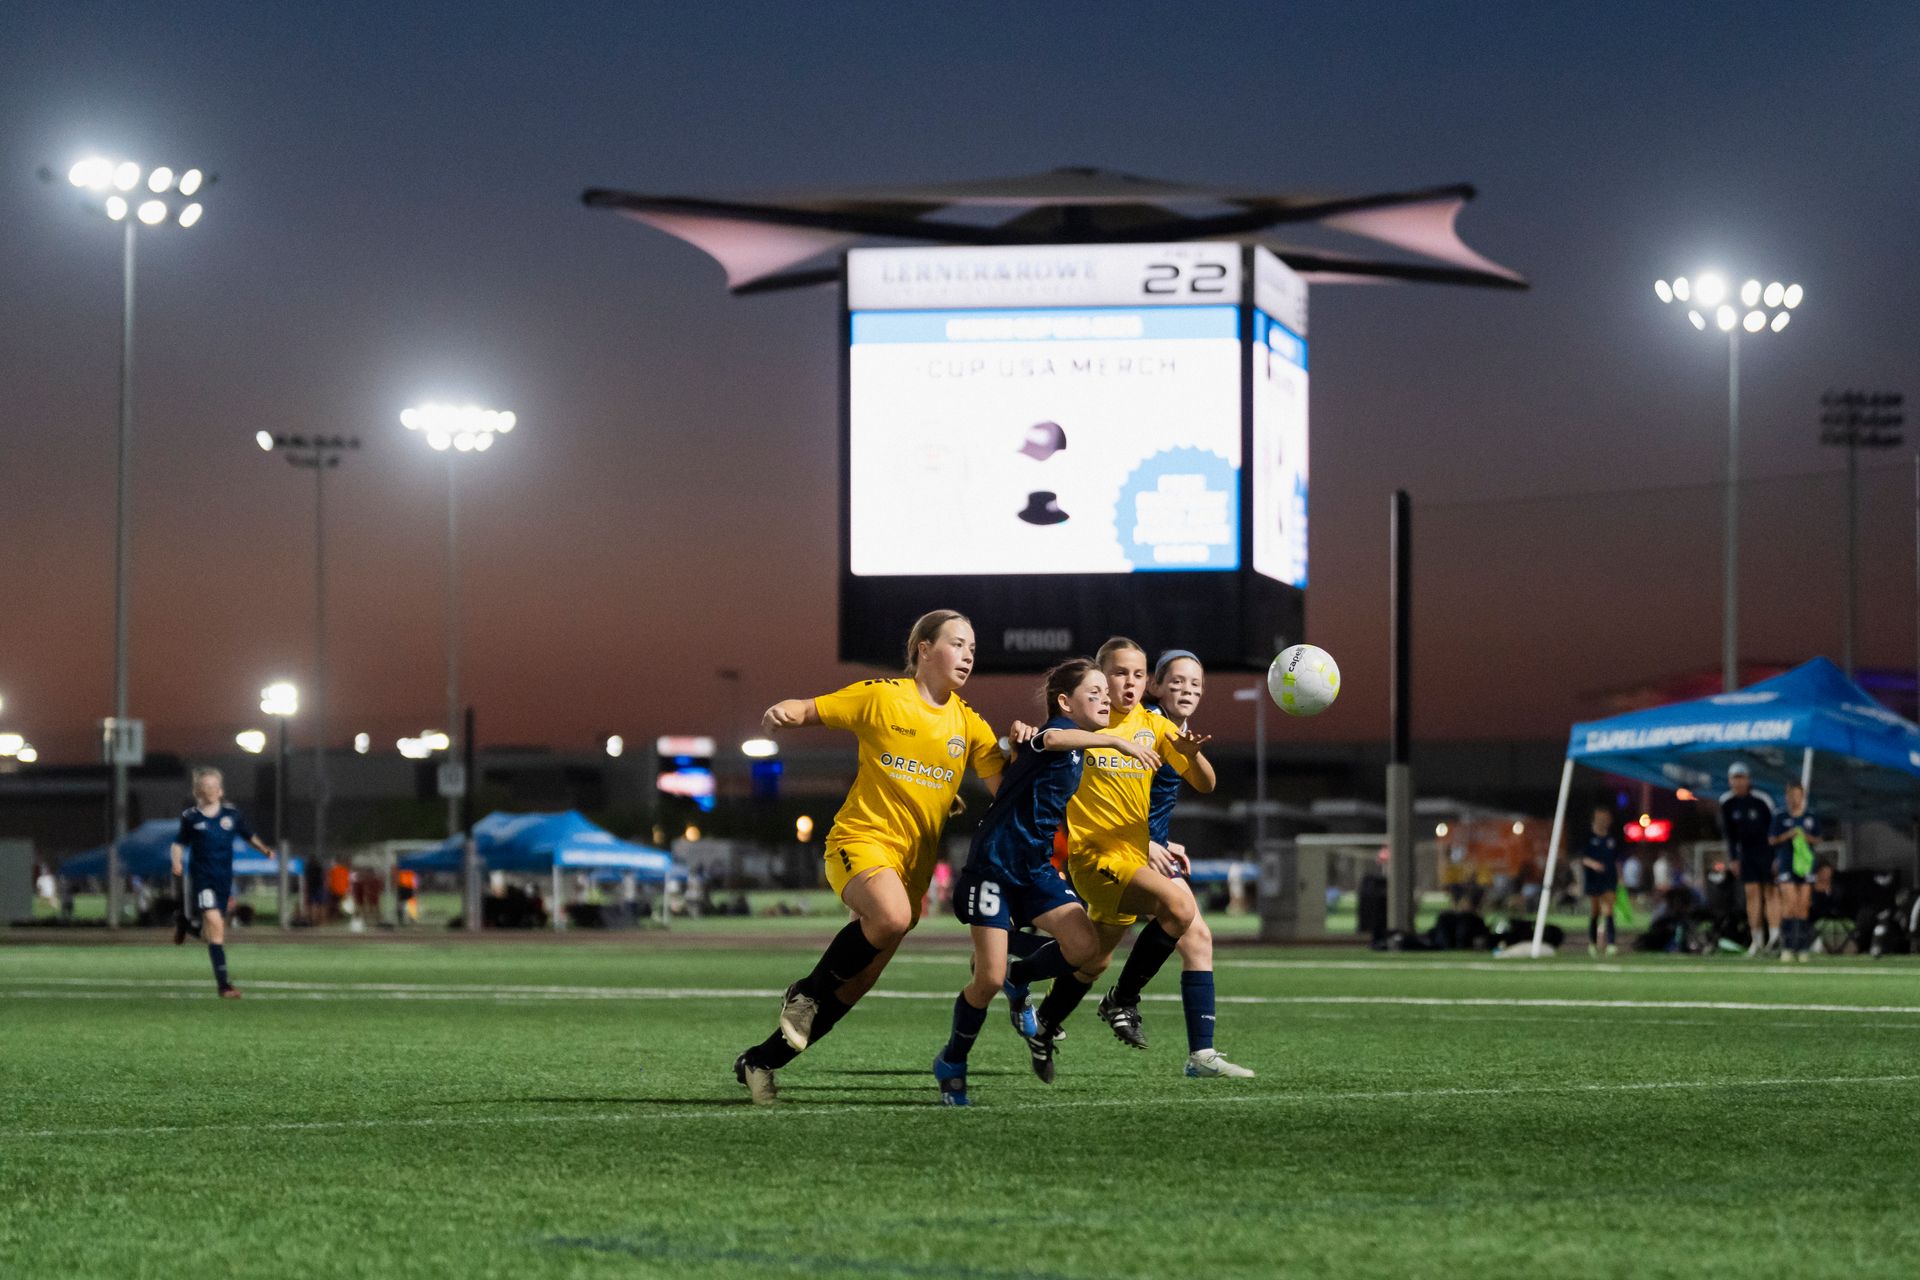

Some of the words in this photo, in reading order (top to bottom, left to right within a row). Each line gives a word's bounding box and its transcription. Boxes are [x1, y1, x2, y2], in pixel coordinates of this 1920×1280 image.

[1142, 263, 1227, 294] 22
[927, 358, 985, 378] CUP
[1071, 356, 1176, 376] MERCH
[890, 724, 917, 737] capelli
[880, 752, 955, 783] OREMOR
[1085, 755, 1150, 771] OREMO
[978, 880, 1001, 917] 6
